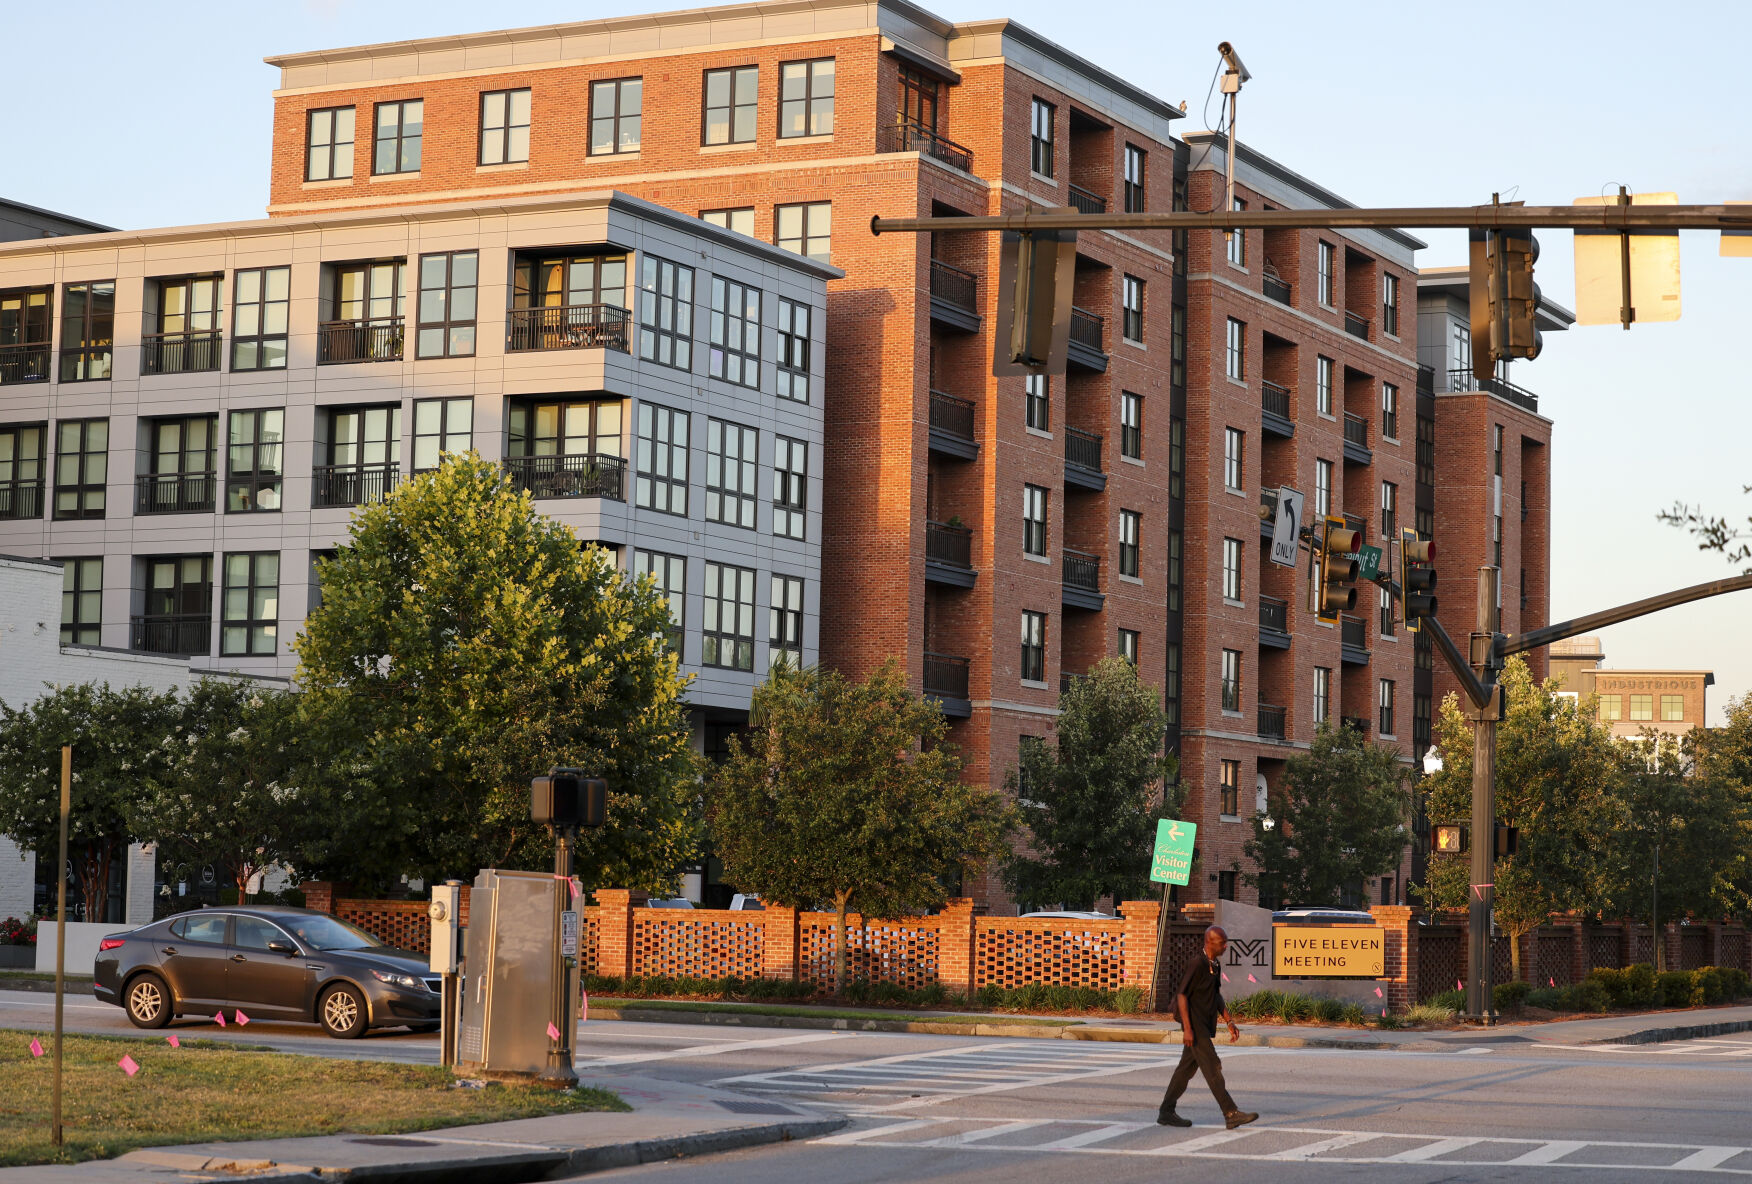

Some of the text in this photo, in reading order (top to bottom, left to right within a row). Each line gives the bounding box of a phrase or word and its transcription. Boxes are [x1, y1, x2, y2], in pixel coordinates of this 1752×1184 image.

[1275, 542, 1295, 560] ONLY
[1369, 552, 1378, 569] St
[1602, 679, 1697, 690] INDUSTRIOUS
[1155, 854, 1188, 869] Visitor
[1153, 866, 1187, 881] Center
[1284, 939, 1379, 950] FIVE ELEVEN
[1284, 956, 1346, 967] MEETING
